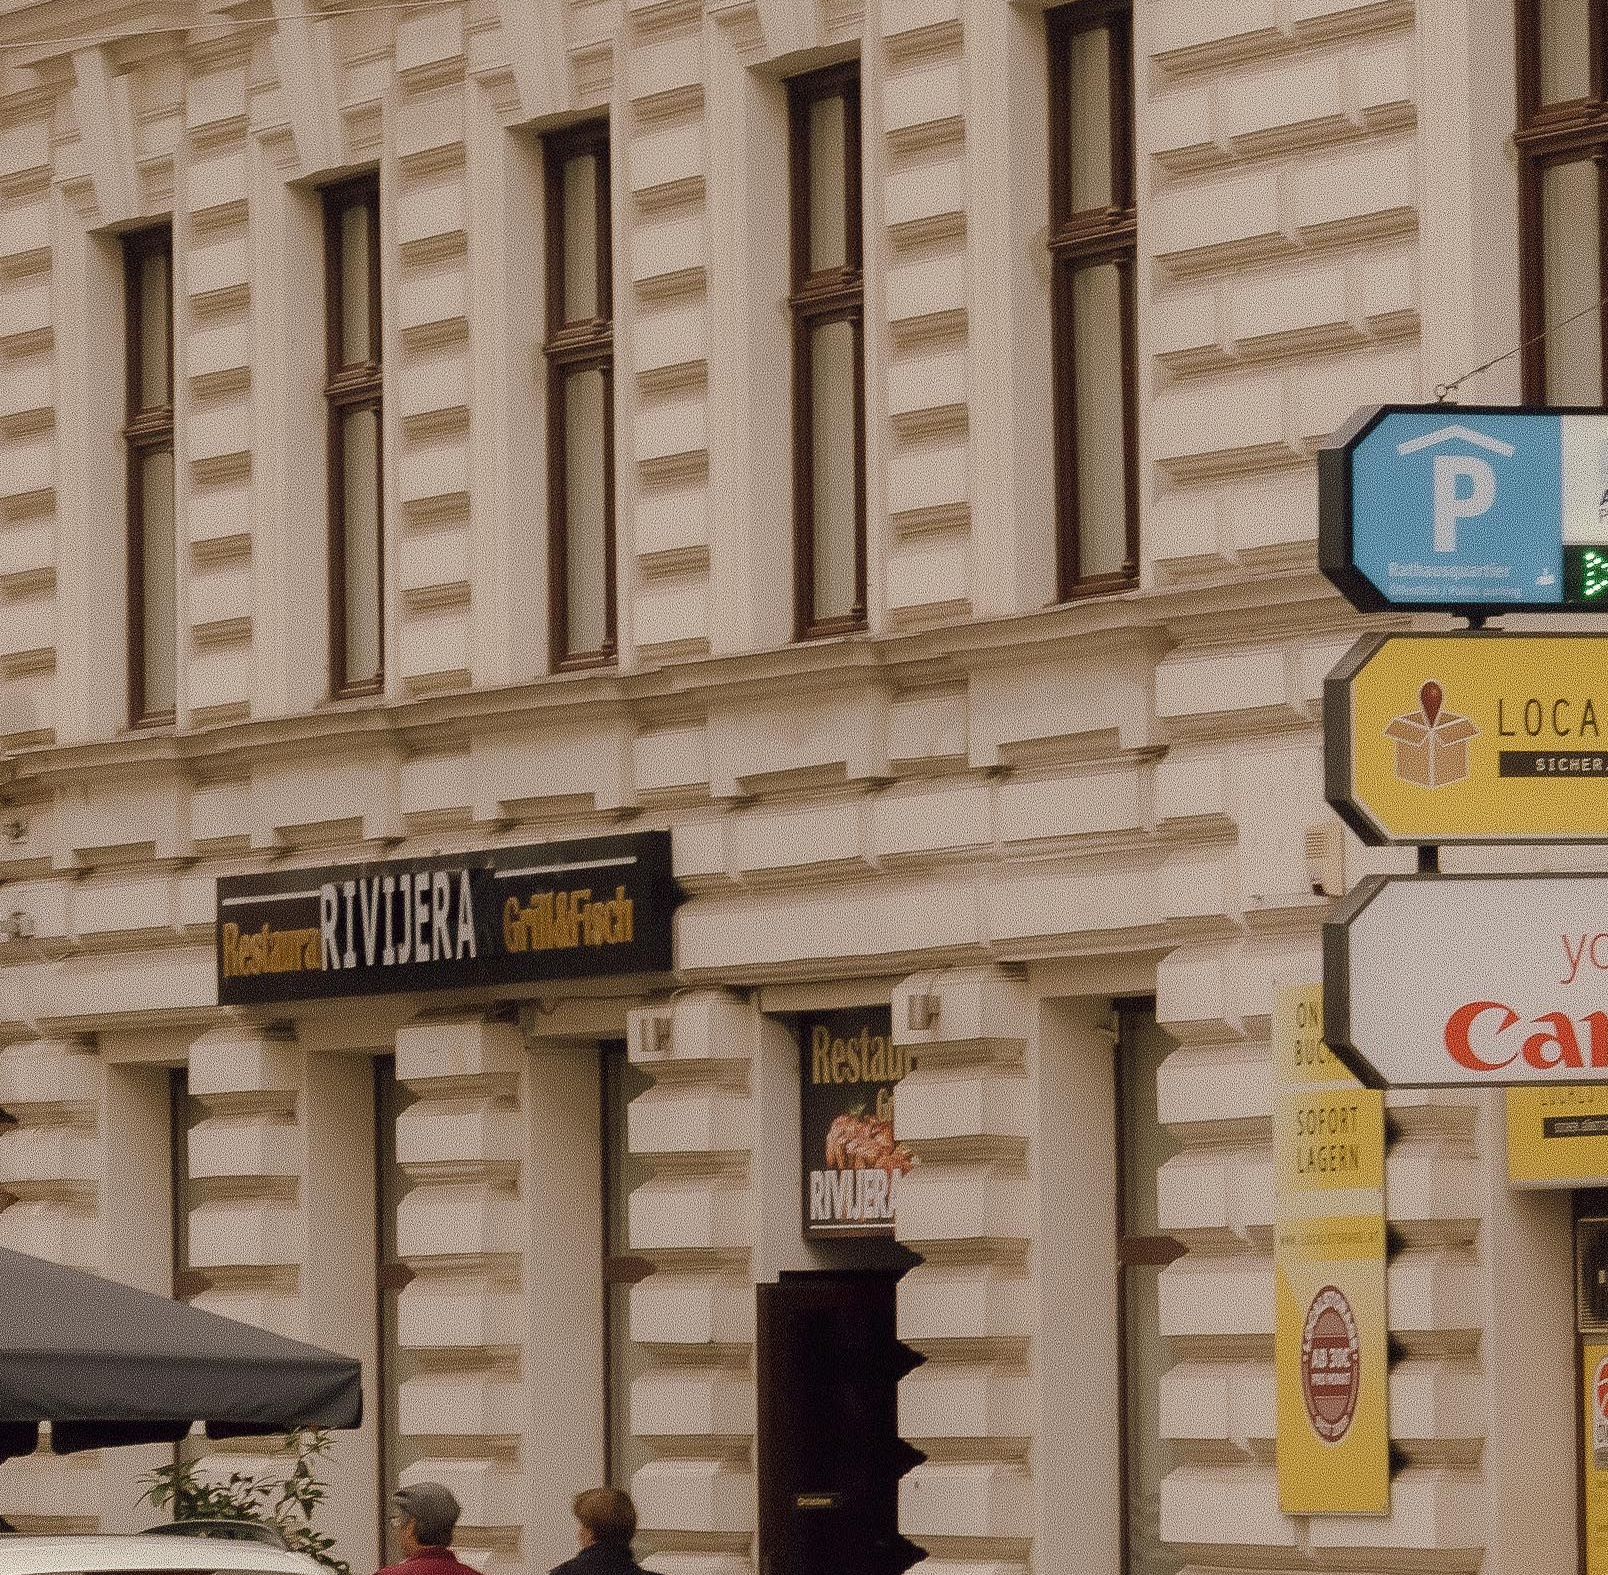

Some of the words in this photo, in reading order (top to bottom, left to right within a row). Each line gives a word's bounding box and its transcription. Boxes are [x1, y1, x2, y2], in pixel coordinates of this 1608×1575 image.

[1434, 455, 1496, 552] P
[320, 869, 477, 971] RIVIJERA
[1296, 1106, 1359, 1136] SOFORT
[1297, 1144, 1360, 1173] LAGERN
